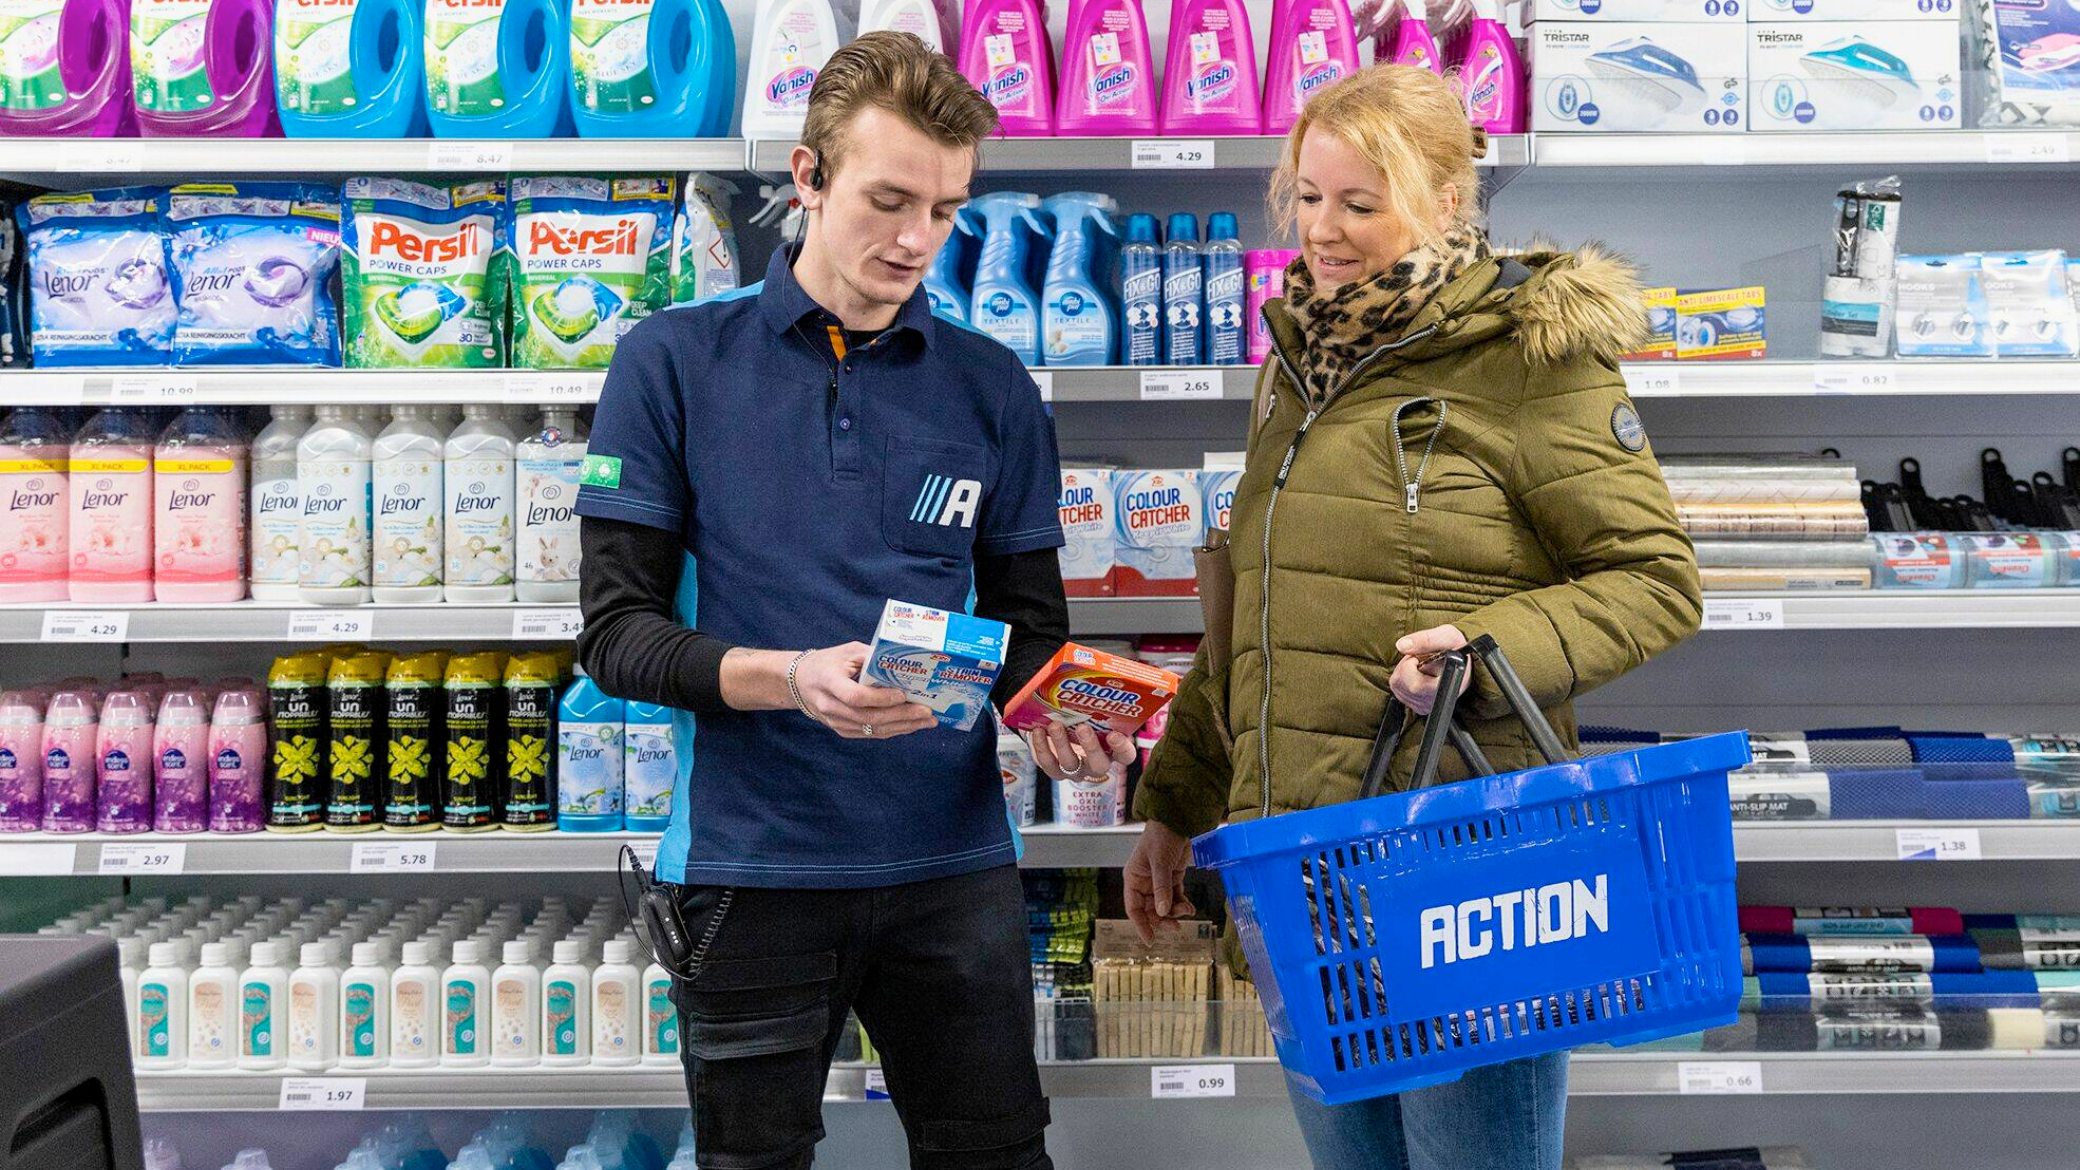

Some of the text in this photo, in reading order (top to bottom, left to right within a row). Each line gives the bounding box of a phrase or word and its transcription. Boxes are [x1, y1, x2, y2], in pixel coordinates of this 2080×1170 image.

[1544, 32, 1589, 42] TRISTAR
[1757, 33, 1803, 43] TRISTAR
[772, 70, 813, 99] Vanish
[982, 68, 1024, 97] Vanish
[1188, 67, 1229, 97] Vanish
[1176, 152, 1202, 161] 4.29
[2031, 146, 2055, 154] 2.49
[476, 155, 502, 164] 8.47
[311, 231, 341, 245] NIEU
[371, 222, 478, 262] Persil
[529, 219, 638, 255] Persil
[369, 260, 447, 275] POWER CAPS
[528, 259, 602, 269] POWER CAPS
[45, 271, 99, 300] Lenor
[186, 271, 241, 300] Lenor
[1898, 283, 1935, 291] HOOKS
[459, 333, 473, 342] 30
[1184, 381, 1210, 391] 2.65
[1645, 379, 1670, 389] 1.08
[1862, 375, 1887, 385] 0.82
[549, 385, 582, 395] 10.49
[178, 463, 189, 471] XL
[10, 490, 60, 511] Lenor
[82, 489, 129, 510] Lenor
[169, 490, 215, 511] Lenor
[304, 495, 347, 516] Lenor
[381, 494, 425, 515] Lenor
[455, 492, 502, 514] Lenor
[938, 479, 982, 528] A
[1126, 487, 1180, 511] COLOUR
[1130, 505, 1190, 529] CATCHER
[525, 562, 534, 570] 46
[1747, 611, 1772, 621] 1.39
[91, 625, 117, 635] 4.29
[332, 623, 358, 632] 4.29
[879, 655, 923, 668] COLOUR
[879, 661, 928, 676] CATCHER
[946, 665, 981, 677] STAIN
[939, 671, 993, 685] REMOVER
[1060, 679, 1140, 705] COLOUR
[1057, 689, 1143, 717] CATCHER
[570, 746, 604, 761] Lenor
[637, 747, 672, 763] Lenor
[1768, 802, 1788, 811] MAT
[1941, 841, 1966, 851] 1.38
[144, 856, 169, 865] 2.97
[400, 854, 426, 865] 5.78
[1420, 873, 1609, 969] ACTION
[1198, 1078, 1224, 1089] 0.99
[1726, 1076, 1752, 1086] 0.66
[327, 1090, 353, 1101] 1.97
